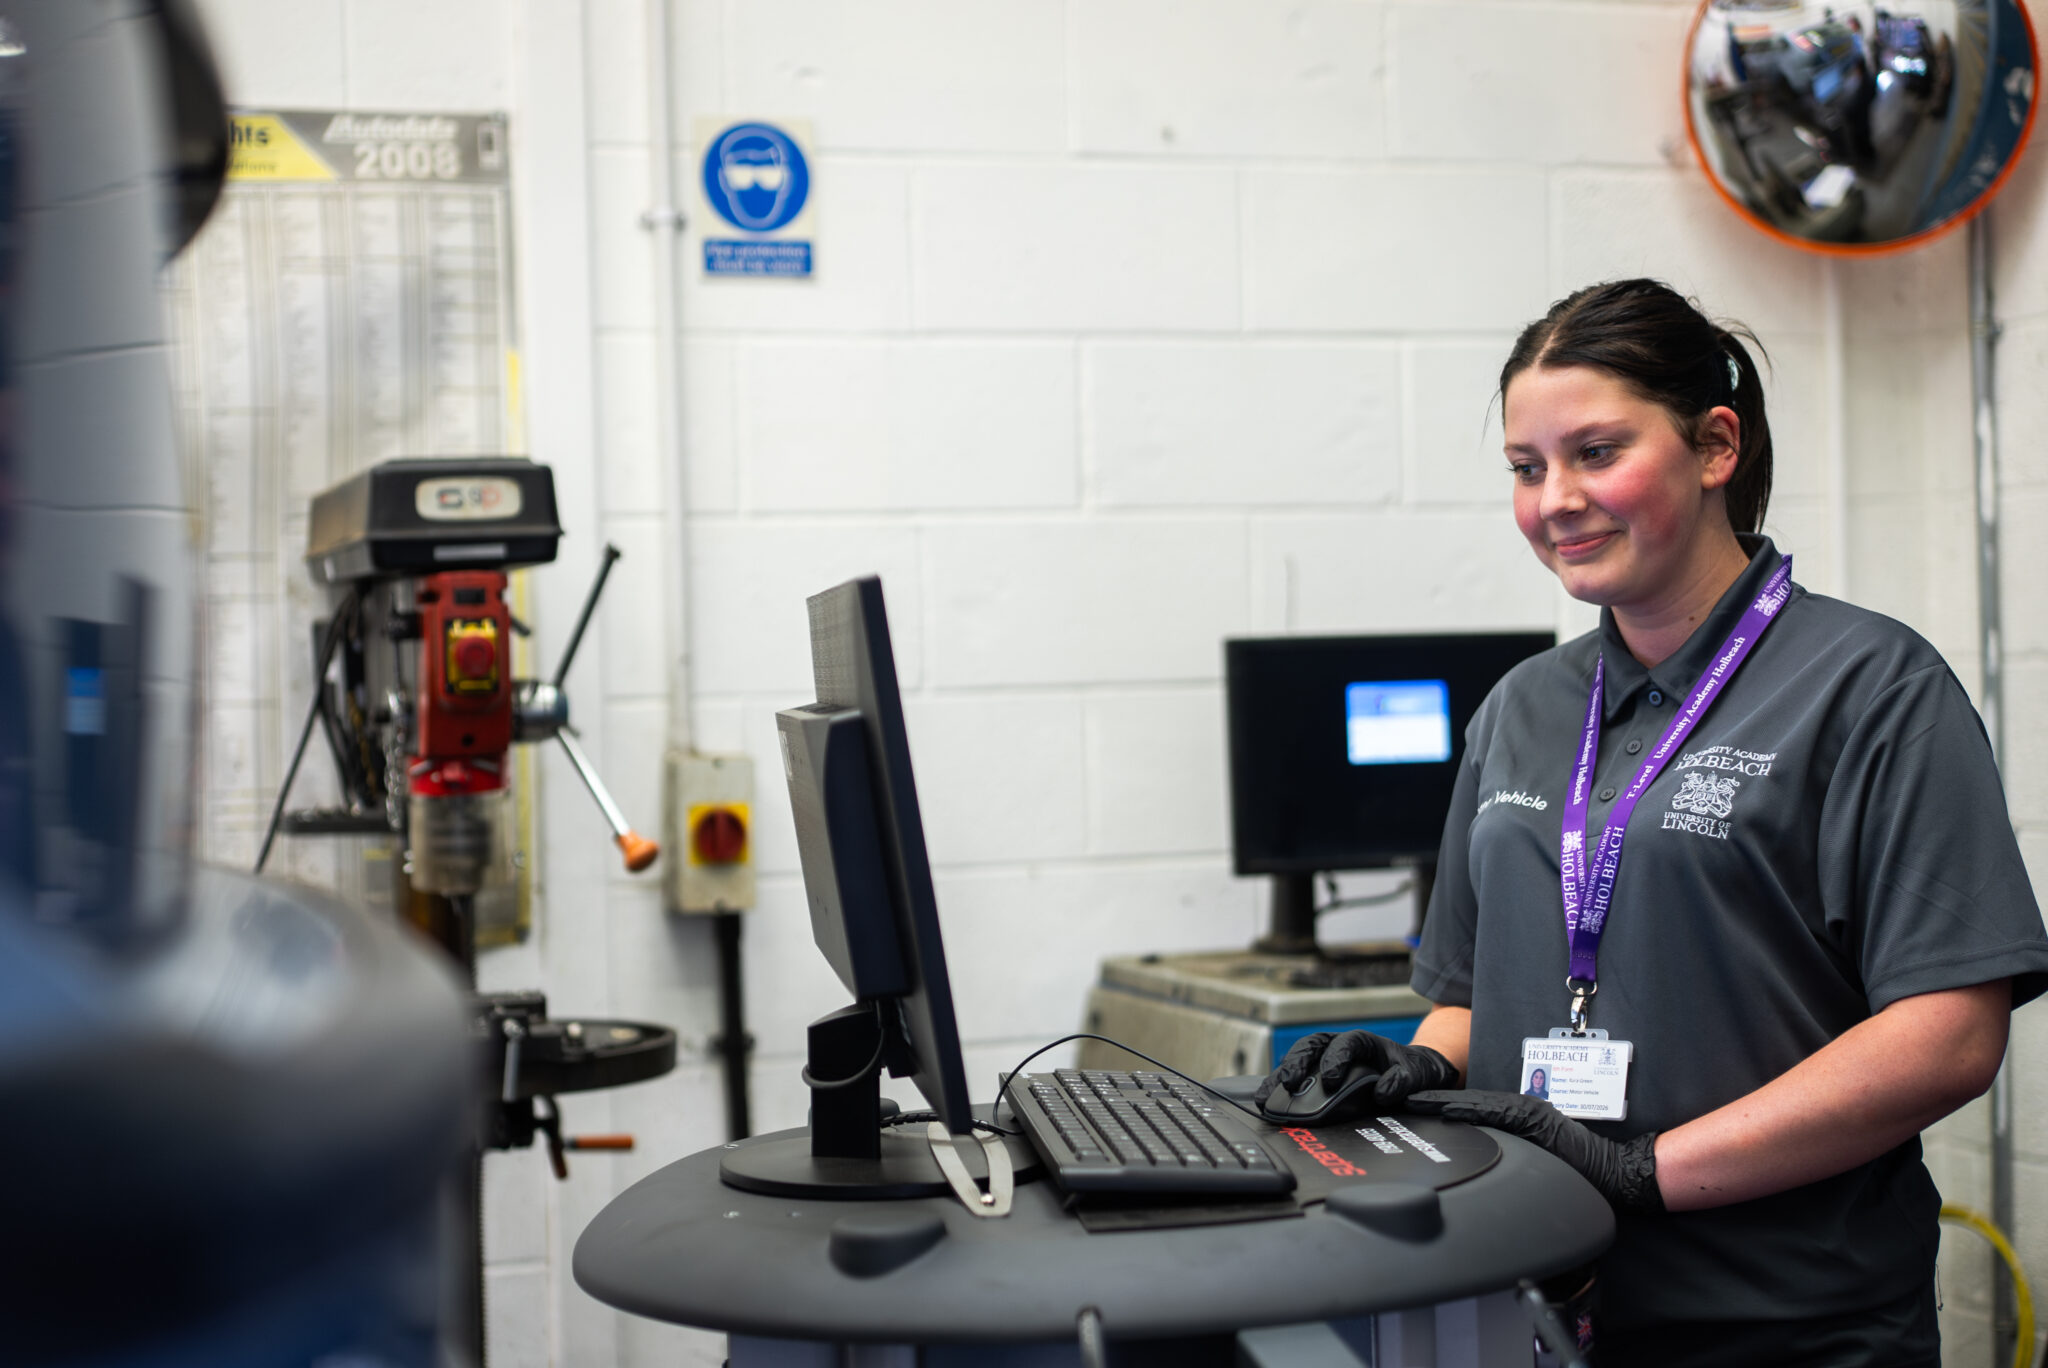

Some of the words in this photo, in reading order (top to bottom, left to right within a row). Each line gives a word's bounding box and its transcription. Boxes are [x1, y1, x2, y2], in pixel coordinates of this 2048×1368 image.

[353, 141, 462, 180] 2008
[1625, 765, 1655, 800] T-Level
[1653, 716, 1692, 759] University
[1686, 677, 1719, 717] Academy
[1712, 635, 1746, 678] Holbeach
[1733, 748, 1778, 762] ACADEMY
[1494, 790, 1548, 811] Vehicle
[1573, 765, 1588, 805] Holbeach
[1661, 818, 1730, 840] LINCOLN
[1663, 811, 1717, 827] UNIVERSITY
[1717, 820, 1733, 829] OF
[1583, 863, 1601, 908] UNIVERSITY
[1596, 825, 1612, 863] ACADEMY
[1594, 826, 1625, 911] HOLBEACH
[1561, 852, 1579, 930] HOLBEACH
[1527, 1050, 1589, 1062] HOLBEACH
